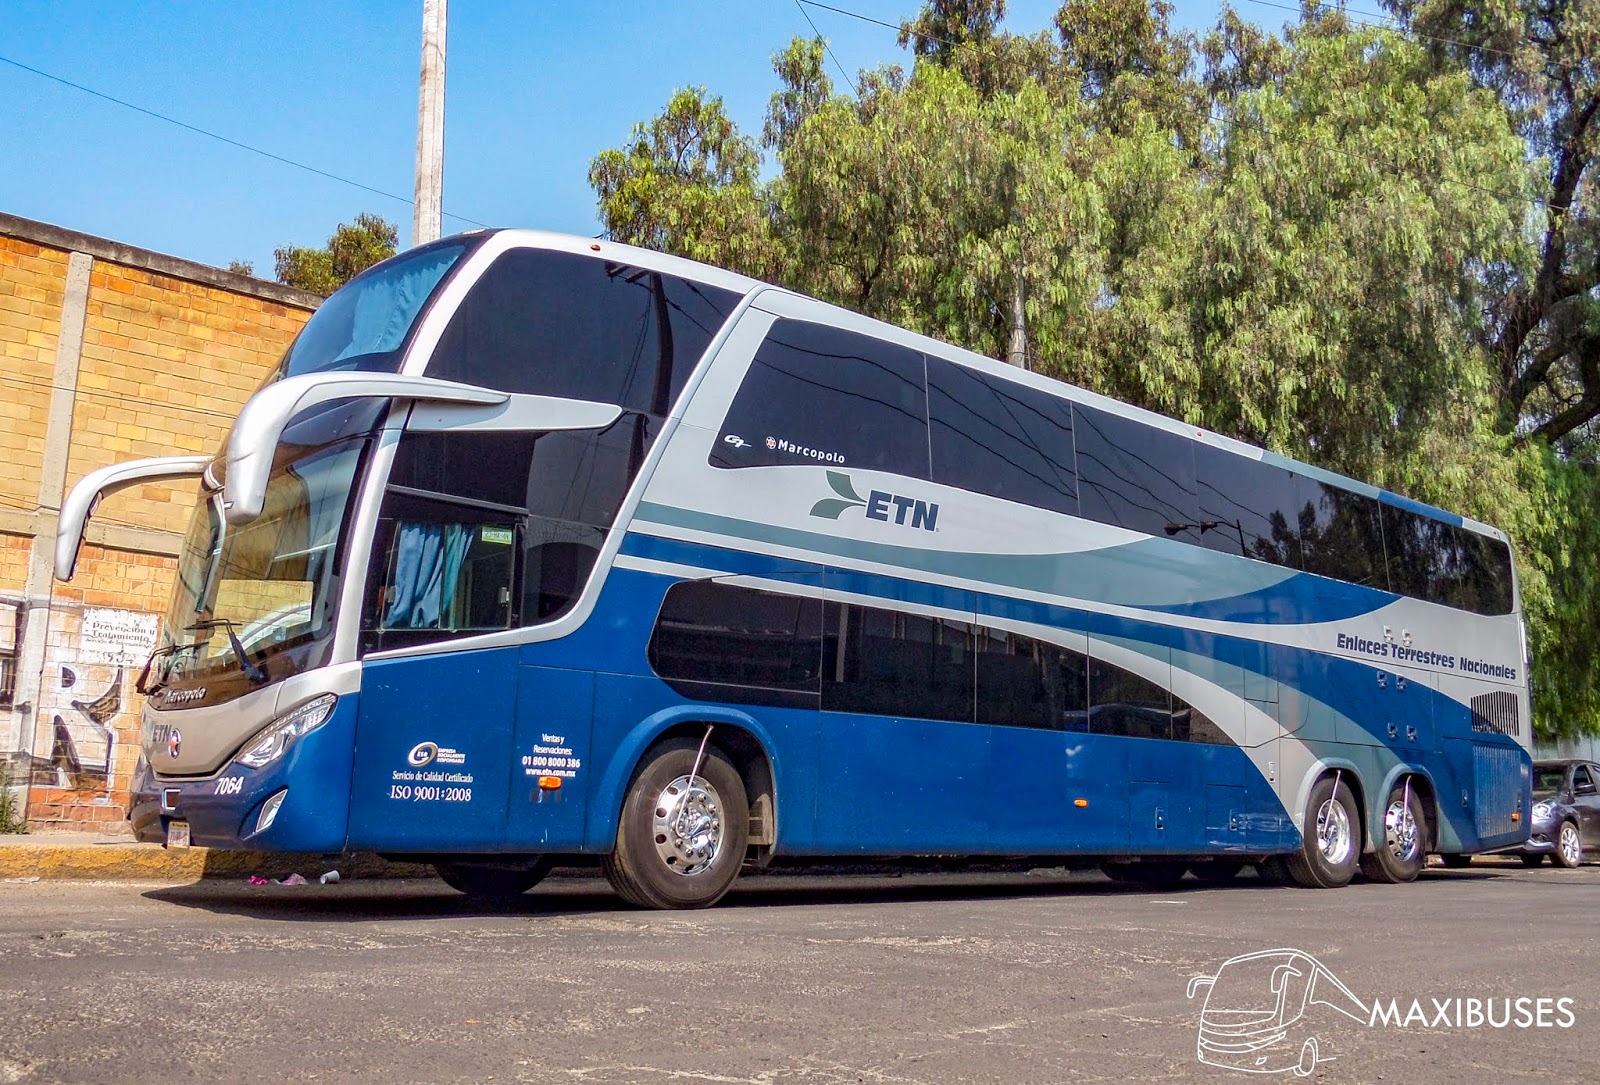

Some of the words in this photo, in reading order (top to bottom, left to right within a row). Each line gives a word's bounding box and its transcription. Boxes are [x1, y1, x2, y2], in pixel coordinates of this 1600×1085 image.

[778, 439, 845, 464] Marcopolo
[866, 490, 939, 531] ETN
[1337, 633, 1388, 656] Enlaces
[1391, 644, 1455, 669] Terrestres
[1460, 657, 1517, 680] Nacionales
[152, 724, 171, 742] ETN
[542, 733, 560, 743] Ventas
[560, 736, 565, 745] y
[522, 755, 532, 766] 01
[532, 756, 547, 767] 800
[547, 756, 567, 768] 8000
[567, 758, 581, 769] 386
[214, 776, 244, 795] 7064
[392, 770, 414, 781] Servicio
[415, 771, 423, 781] de
[423, 771, 444, 782] Calidad
[445, 773, 474, 783] Certificado
[390, 785, 412, 799] ISO
[413, 786, 472, 802] 9001:2008
